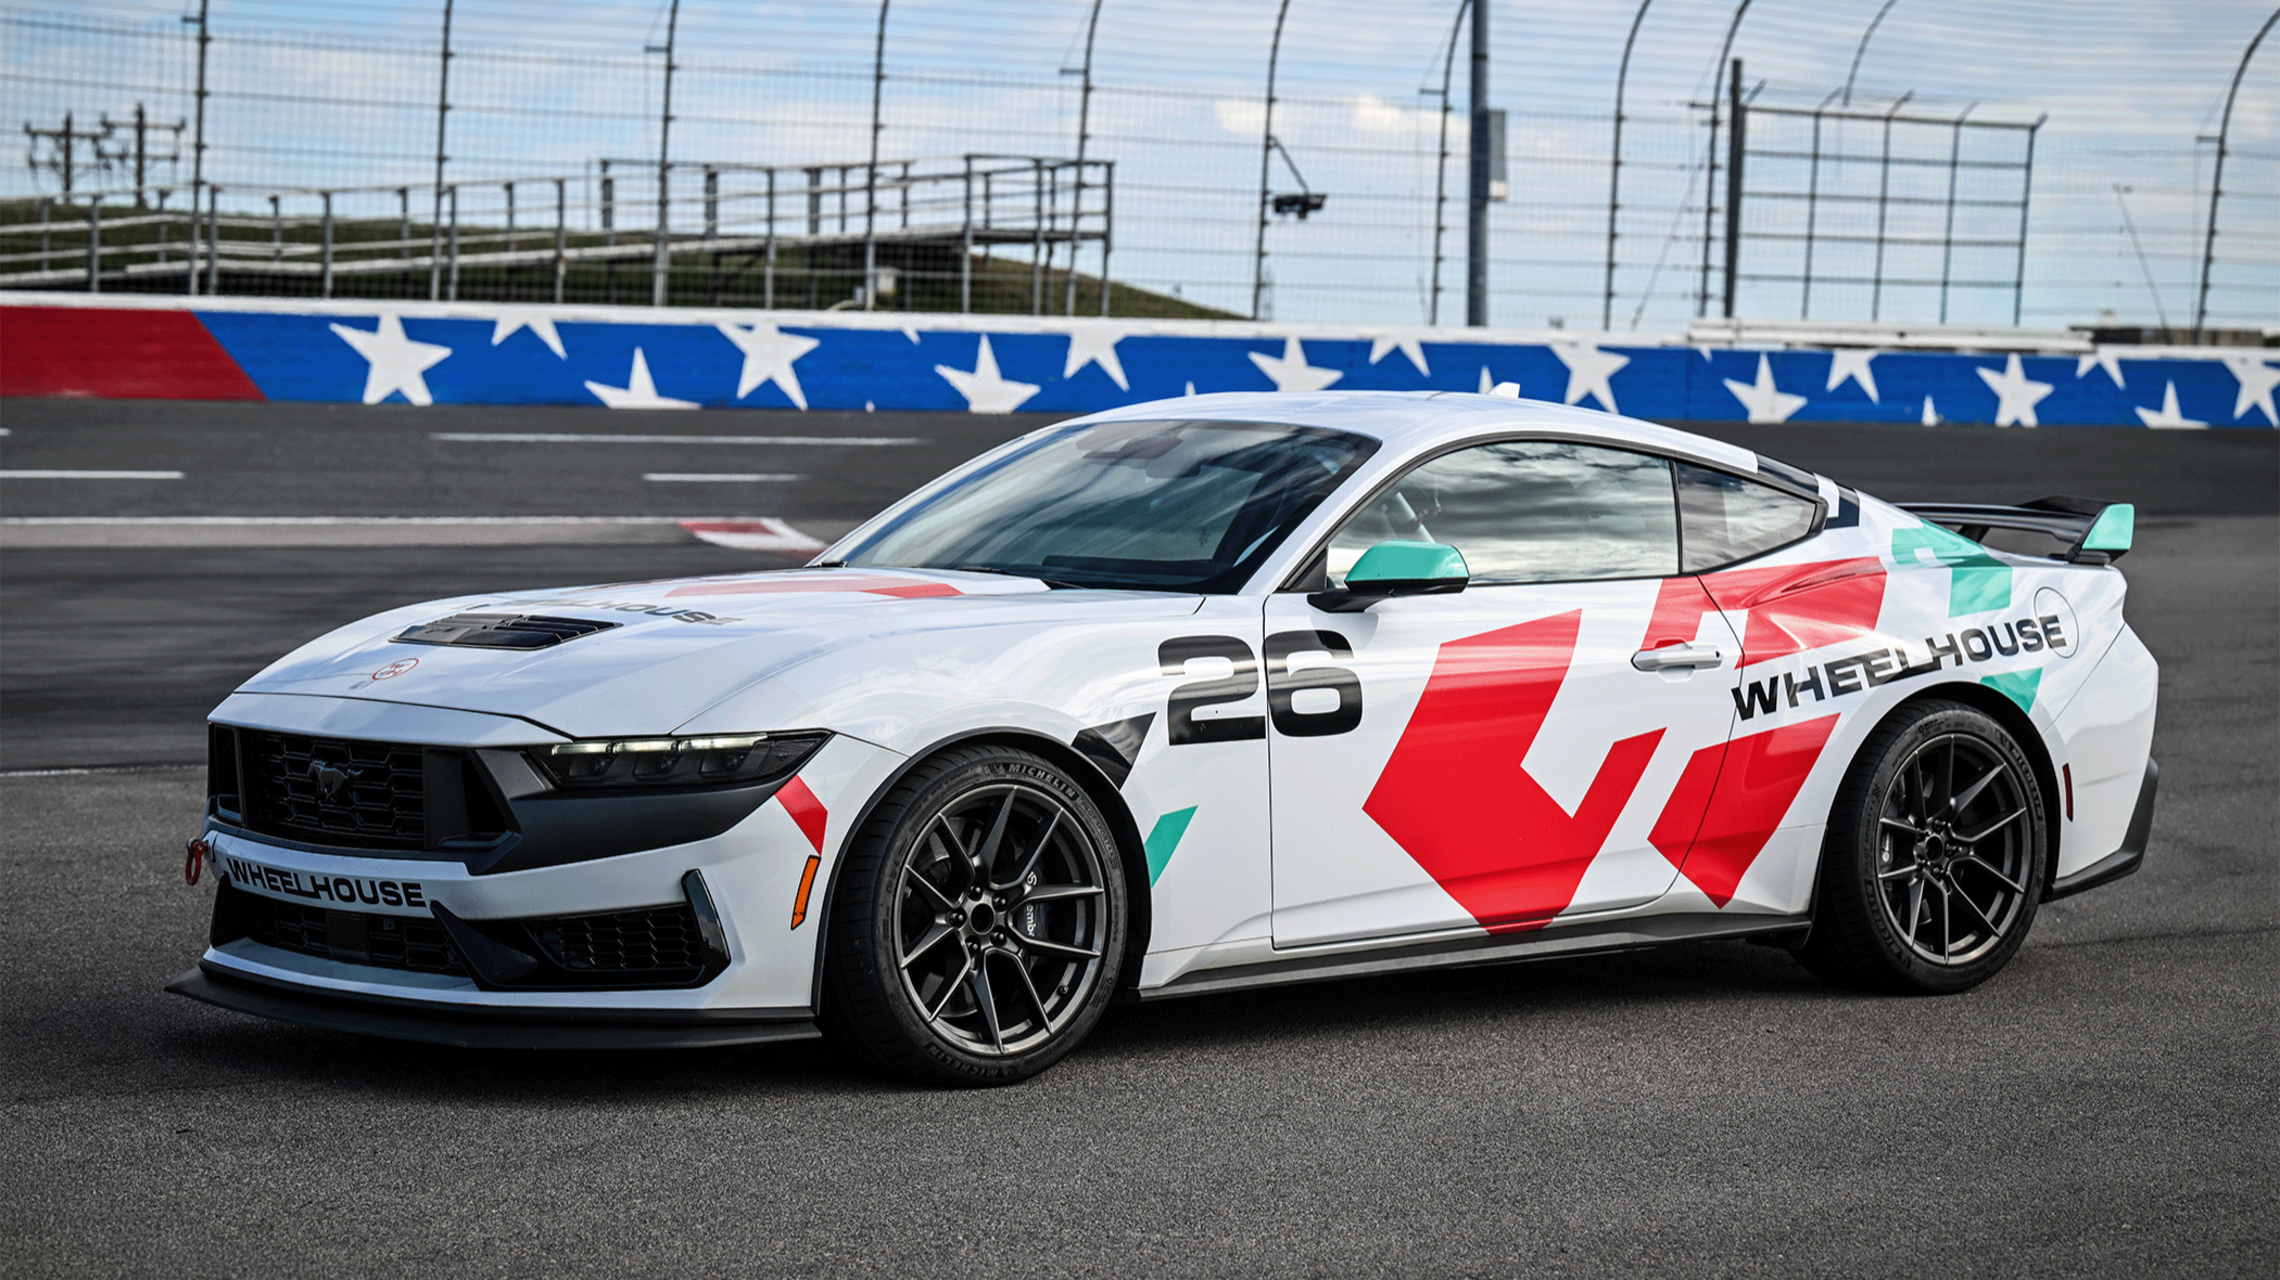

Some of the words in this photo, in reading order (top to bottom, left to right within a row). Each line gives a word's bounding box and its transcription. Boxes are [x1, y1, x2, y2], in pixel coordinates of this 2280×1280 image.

[1158, 629, 1363, 746] 26
[1731, 615, 2067, 721] WHEELHOUSE
[1008, 763, 1076, 798] MICHELIN
[2011, 747, 2042, 817] MICHELIN
[226, 857, 427, 907] WHEELHOUSE
[1865, 882, 1900, 956] MICHELIN
[928, 1044, 998, 1077] MICHELIN
